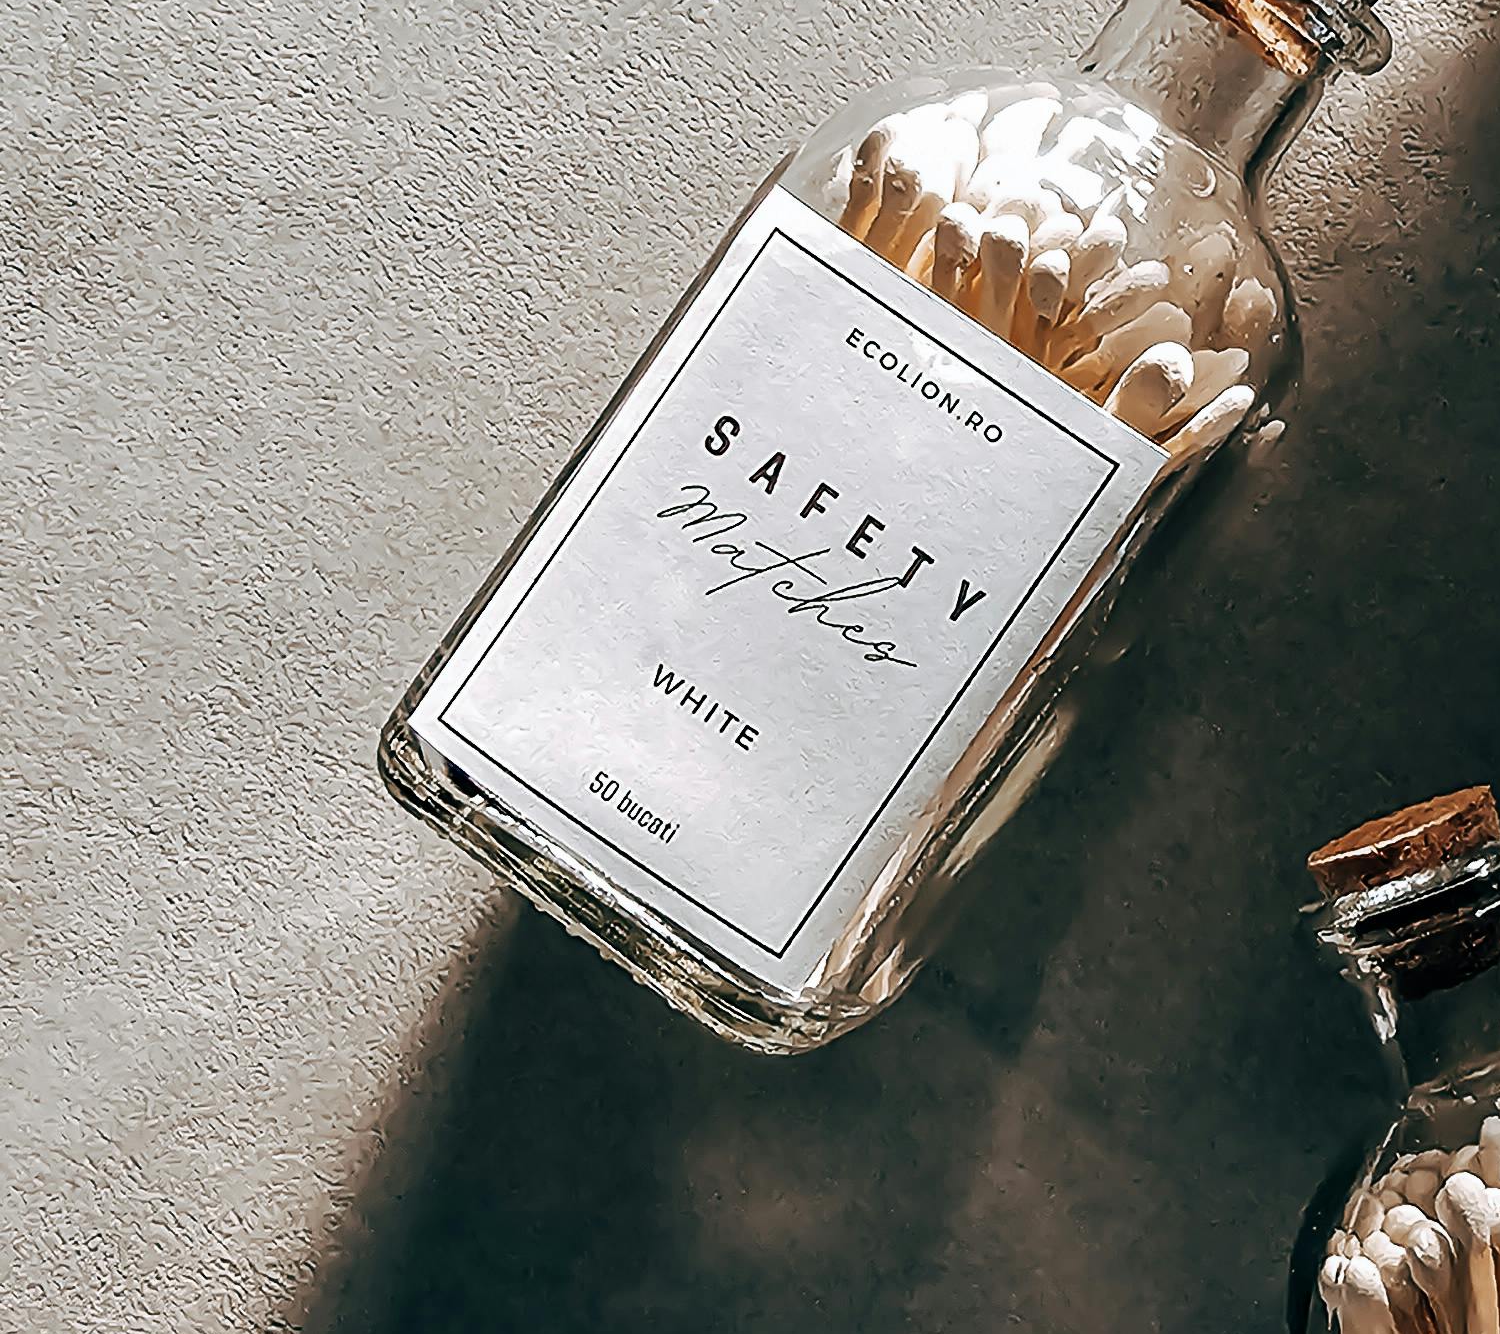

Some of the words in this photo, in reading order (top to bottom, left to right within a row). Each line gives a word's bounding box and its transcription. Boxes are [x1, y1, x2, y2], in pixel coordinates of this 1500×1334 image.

[845, 327, 1004, 443] ECOLION.RO
[657, 485, 917, 668] Matches
[704, 415, 986, 622] SAFETY
[652, 663, 759, 751] WHITE
[589, 770, 619, 800] 50
[619, 790, 680, 844] bucati
